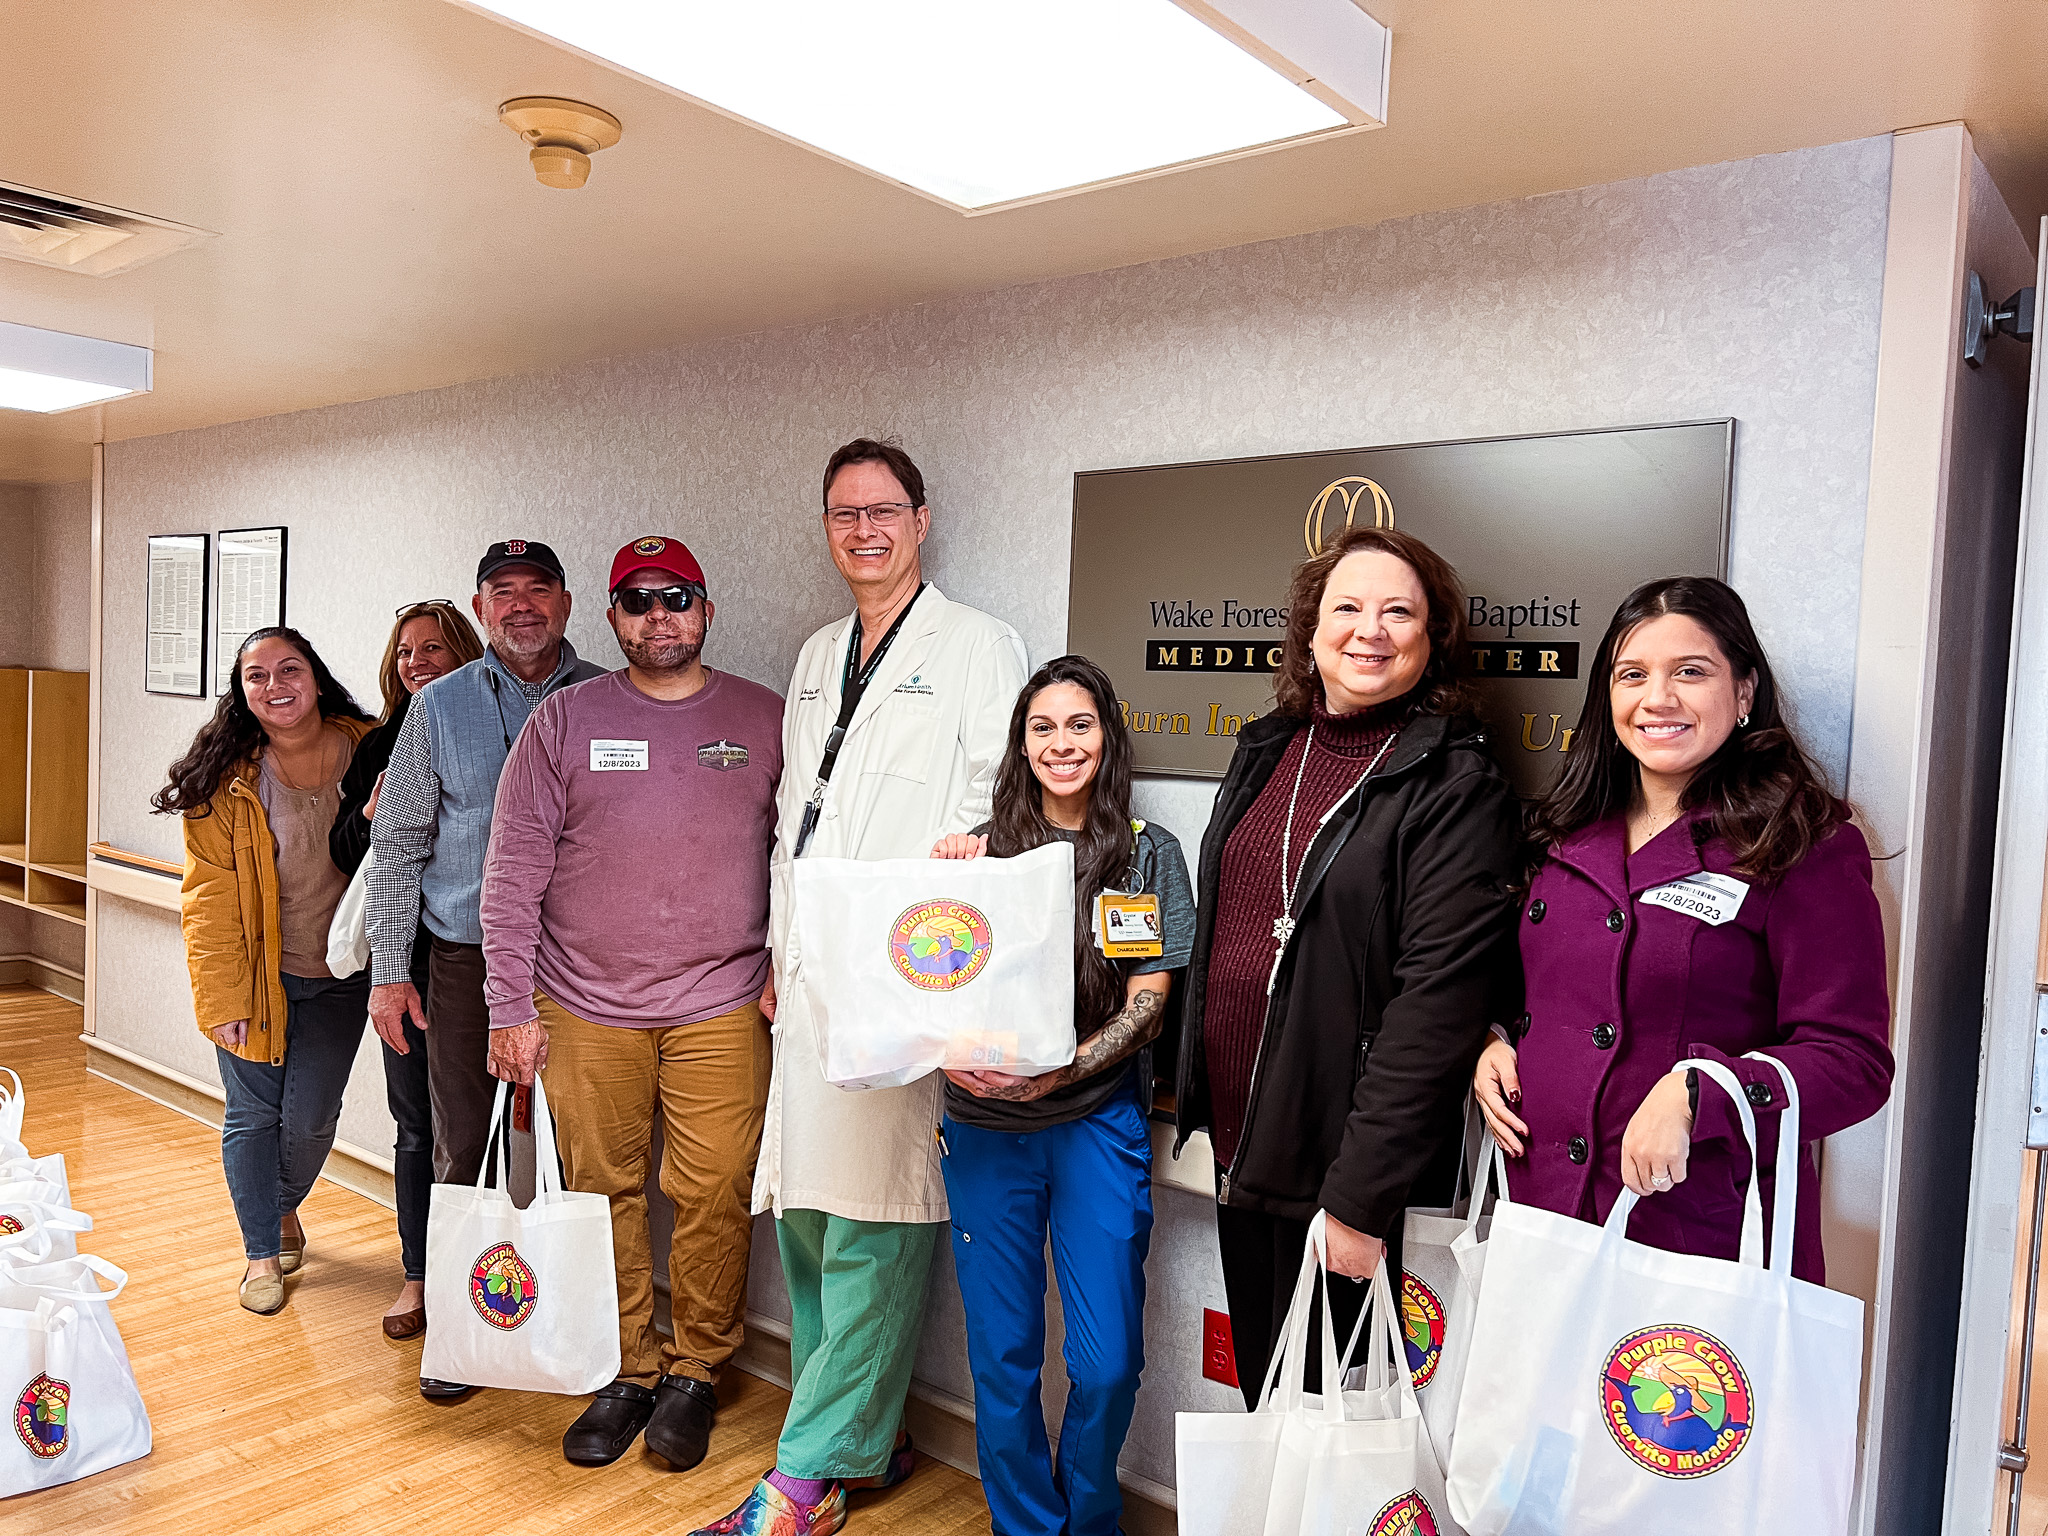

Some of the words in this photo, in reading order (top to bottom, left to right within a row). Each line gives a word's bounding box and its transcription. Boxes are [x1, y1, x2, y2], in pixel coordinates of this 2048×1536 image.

[1150, 600, 1213, 628] Wake
[1221, 600, 1289, 628] Fores
[1467, 595, 1581, 638] Baptist
[1158, 647, 1283, 667] MEDIC
[1472, 649, 1560, 672] TER
[598, 760, 641, 768] 12/8/2023
[899, 906, 943, 935] Purple
[947, 905, 980, 929] Crow
[1655, 891, 1721, 921] 12/8/2023
[899, 955, 943, 985] Cuervito
[947, 948, 983, 985] Morado
[2, 1218, 18, 1235] Cro
[480, 1246, 513, 1271] Purple
[475, 1288, 504, 1324] Cuervito
[505, 1301, 529, 1325] Morado
[1404, 1279, 1440, 1320] Crow
[1411, 1349, 1438, 1382] orado
[1617, 1333, 1687, 1371] Purple
[1693, 1341, 1740, 1393] Crow
[1610, 1399, 1671, 1467] Cuervito
[1676, 1428, 1736, 1470] Morado
